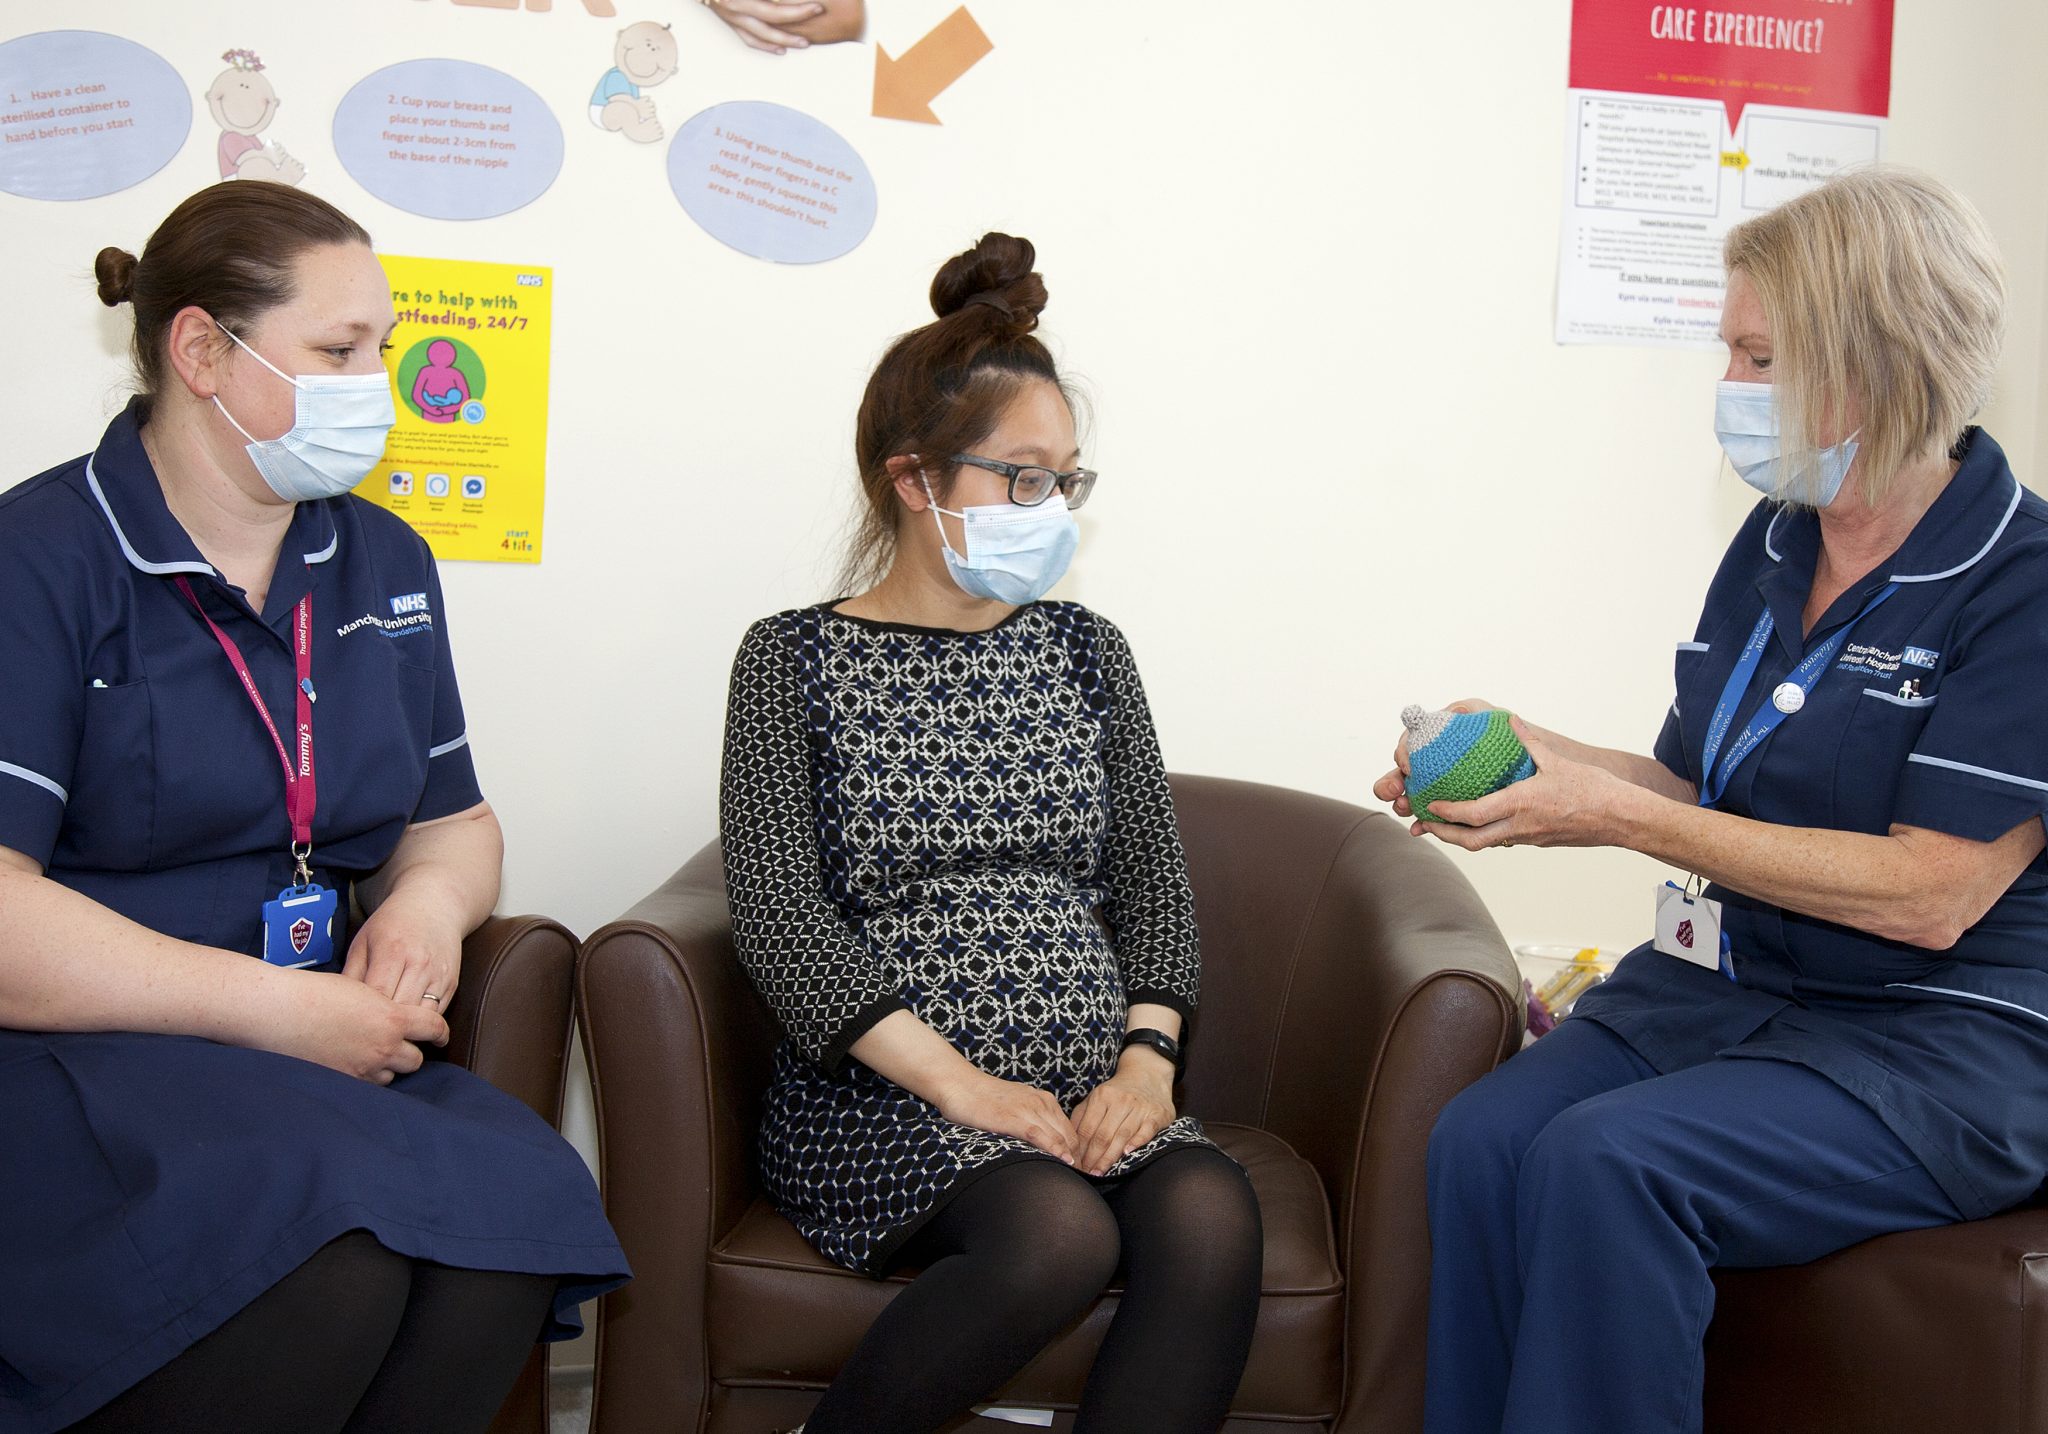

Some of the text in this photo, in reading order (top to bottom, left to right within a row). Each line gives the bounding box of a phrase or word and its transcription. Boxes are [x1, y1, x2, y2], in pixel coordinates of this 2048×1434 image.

[1651, 6, 1825, 54] CARE EXPERIENCE?
[10, 83, 106, 104] 1. Have a clean
[0, 99, 130, 124] sterilised container to
[388, 94, 512, 115] 2. Cup your breast and
[5, 117, 134, 143] hand before you start
[388, 113, 510, 132] place your thumb and
[382, 130, 415, 144] finger
[417, 134, 450, 146] about
[489, 138, 516, 151] from
[389, 148, 509, 169] the base of the nipple
[725, 130, 753, 150] Using
[756, 142, 779, 157] your
[780, 150, 814, 170] thumb
[815, 161, 835, 177] and
[835, 170, 853, 183] the
[1723, 155, 1742, 166] YES
[1787, 151, 1809, 164] Then
[1811, 155, 1823, 167] go
[719, 148, 740, 163] rest
[751, 157, 774, 173] your
[775, 165, 809, 186] fingers
[811, 179, 821, 190] in
[822, 184, 829, 194] a
[831, 185, 839, 198] C
[709, 162, 838, 215] shape, gently squeeze this
[736, 189, 755, 205] this
[756, 197, 804, 221] shouldn't
[518, 274, 543, 287] NHS
[1628, 275, 1642, 284] you
[1645, 274, 1663, 284] have
[392, 290, 518, 311] re to help with
[1638, 294, 1649, 302] via
[397, 309, 529, 331] stfeeding, 24/7
[500, 538, 510, 550] 4
[506, 530, 529, 538] start
[392, 593, 429, 614] NHS
[337, 611, 432, 637] Manch University
[299, 629, 307, 655] Trusted
[1756, 617, 1774, 653] Midwiv
[1904, 648, 1940, 668] NHS
[1873, 669, 1892, 680] Trust
[299, 723, 312, 777] Tommy's
